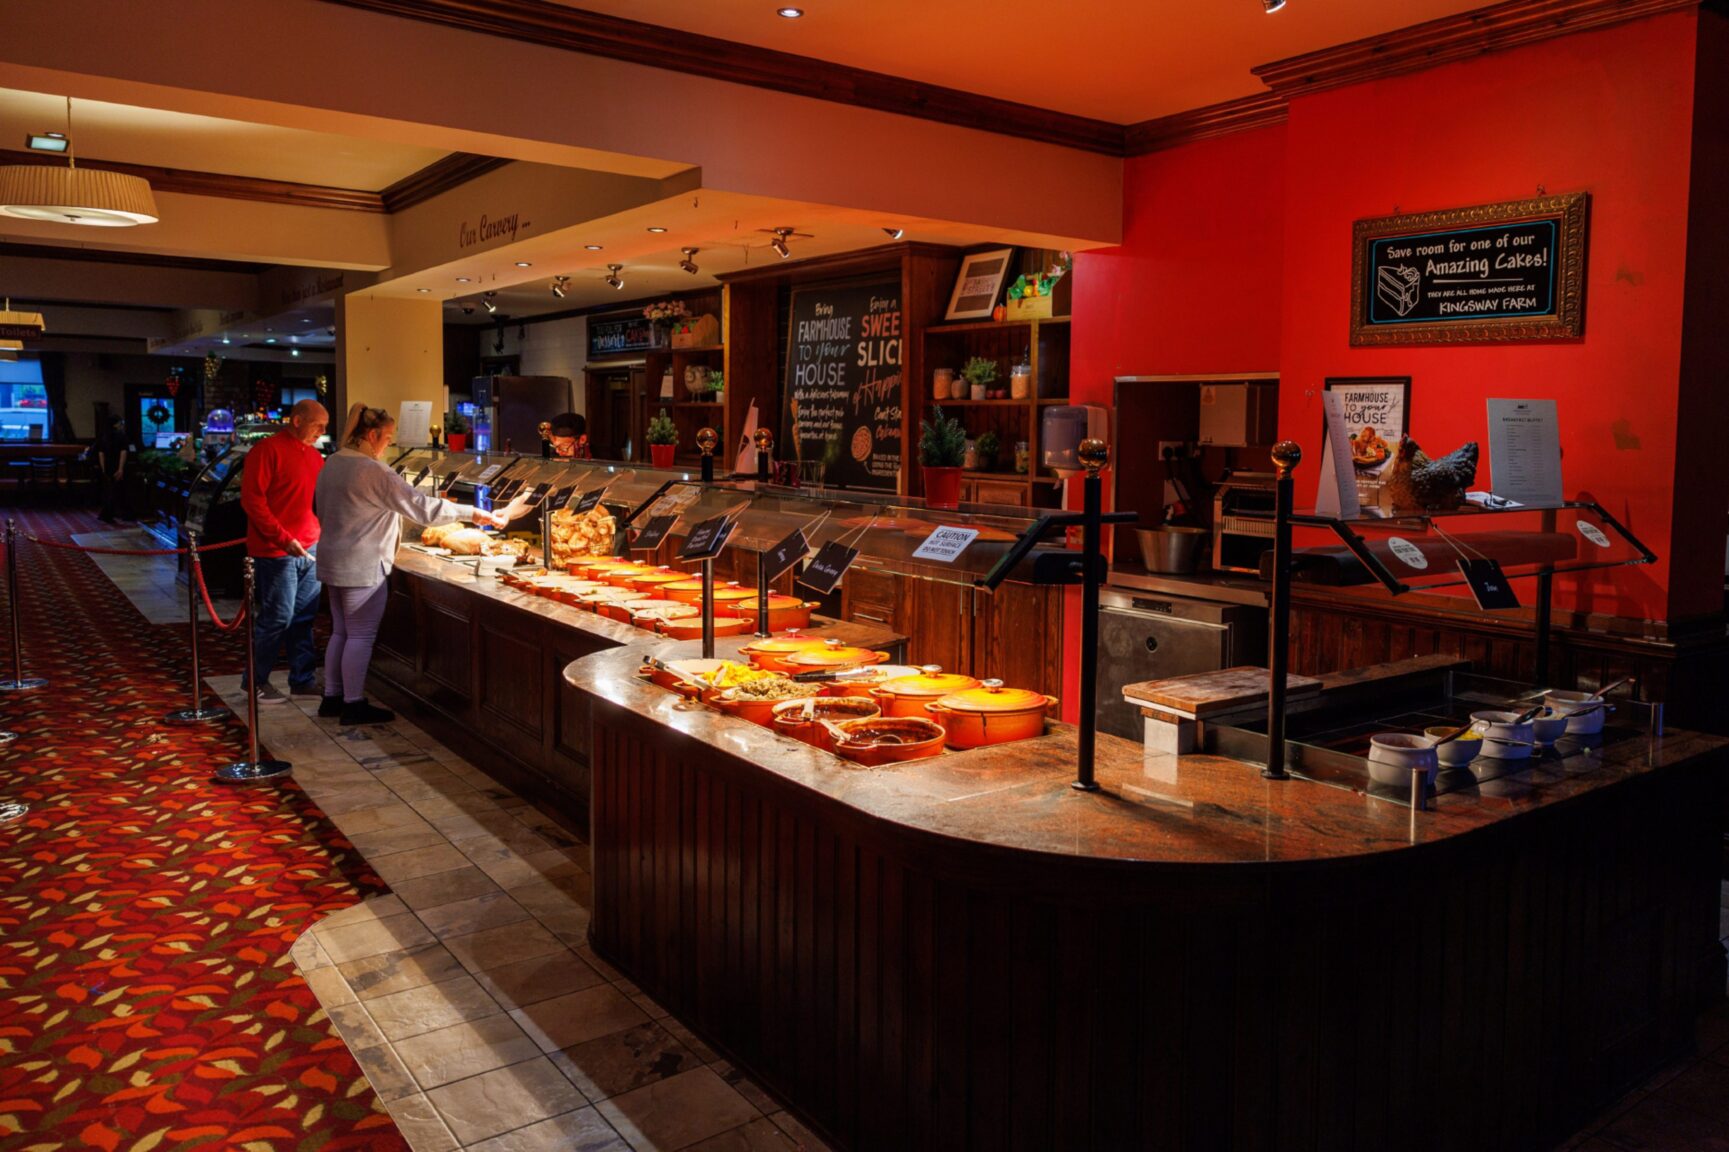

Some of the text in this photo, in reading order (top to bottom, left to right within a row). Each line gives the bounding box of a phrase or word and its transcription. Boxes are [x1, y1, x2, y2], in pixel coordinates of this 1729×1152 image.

[460, 222, 476, 248] Our
[480, 214, 518, 241] Carvery
[1387, 234, 1535, 259] Save room for one of our
[1425, 247, 1547, 278] Amazing Cakes!
[1442, 290, 1455, 298] ARE
[1488, 286, 1506, 294] MADE
[1508, 284, 1526, 292] HERE
[1527, 283, 1536, 292] AT
[1438, 297, 1537, 315] KINGSWAY FARM
[798, 316, 852, 343] FARMHOUSE
[861, 311, 901, 338] SWEE
[799, 342, 850, 366] TO your
[795, 362, 846, 386] HOUSE
[1344, 392, 1389, 403] FARMHOUSE
[1344, 404, 1386, 418] TO your
[1344, 412, 1387, 424] HOUSE
[936, 530, 971, 541] CAUTION
